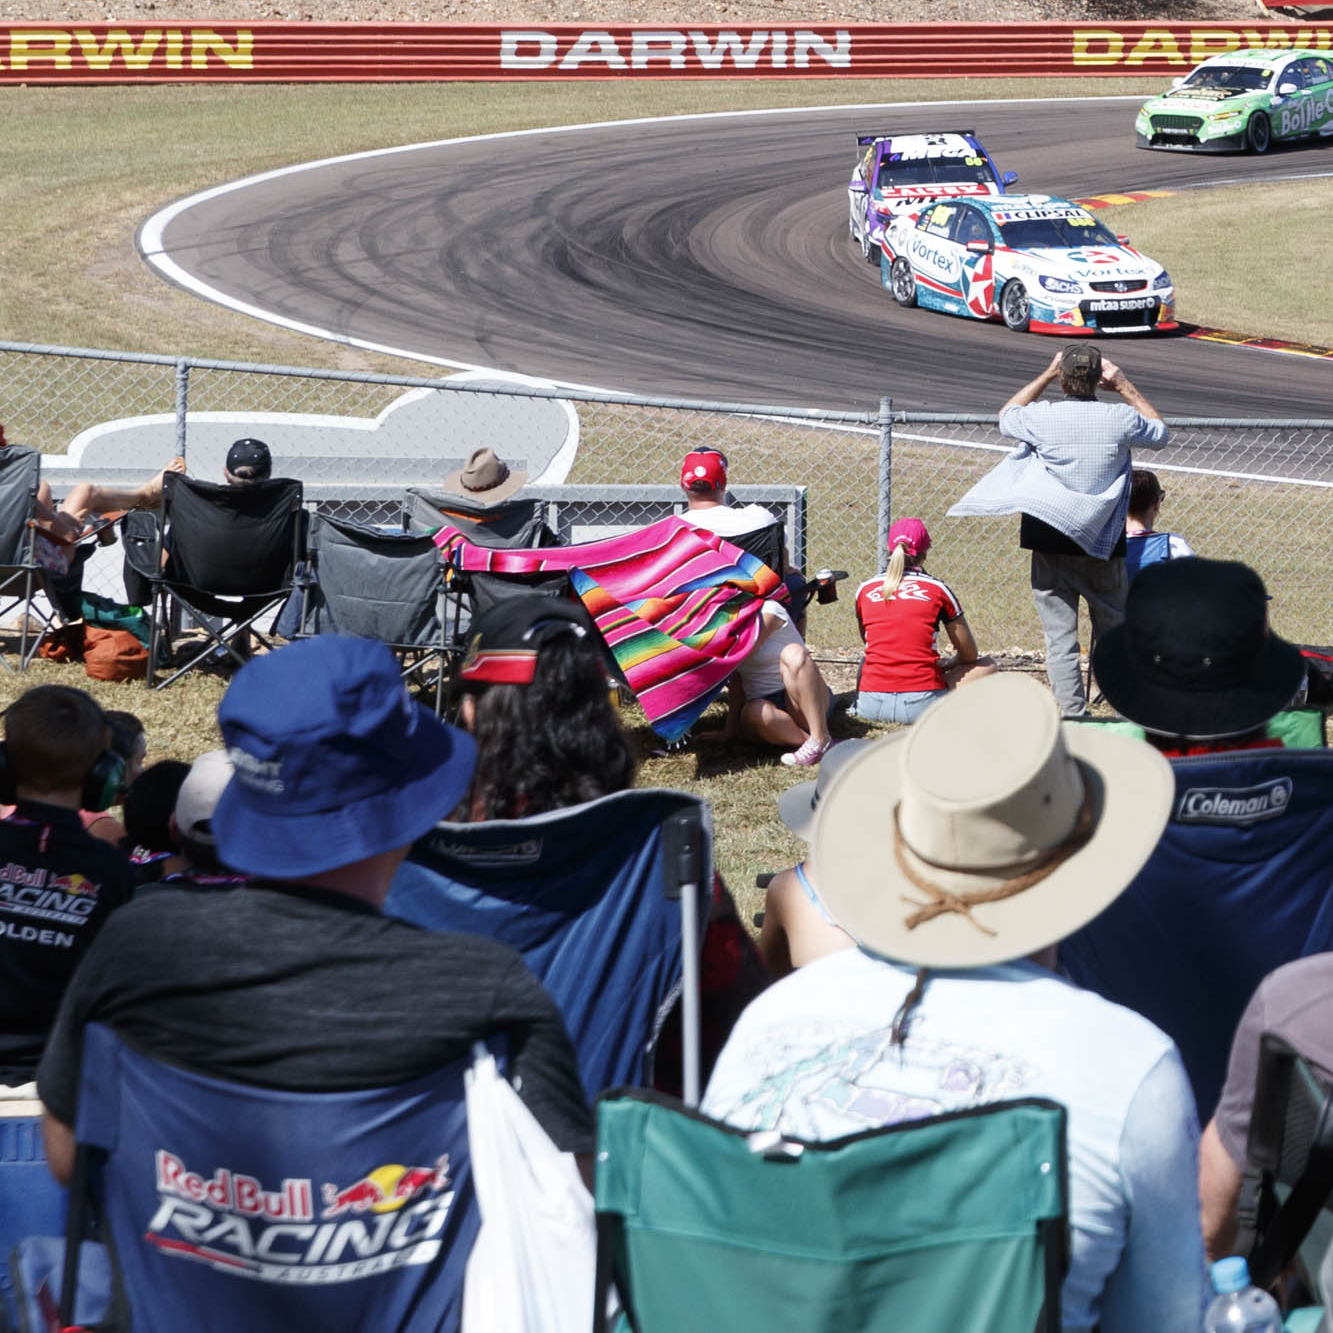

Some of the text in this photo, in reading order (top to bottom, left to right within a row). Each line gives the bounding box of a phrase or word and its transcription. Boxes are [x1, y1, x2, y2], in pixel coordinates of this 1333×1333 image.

[500, 30, 852, 70] DARWIN
[881, 183, 982, 196] CALTEX
[1015, 209, 1084, 219] CLIPSAL
[912, 241, 953, 274] Vortex
[1076, 268, 1146, 277] Vortex
[1044, 278, 1083, 294] SACHS
[1090, 298, 1147, 312] mtaa super
[1187, 790, 1269, 816] Coleman
[156, 1149, 314, 1223] Red Bull
[150, 1191, 456, 1265] RACING
